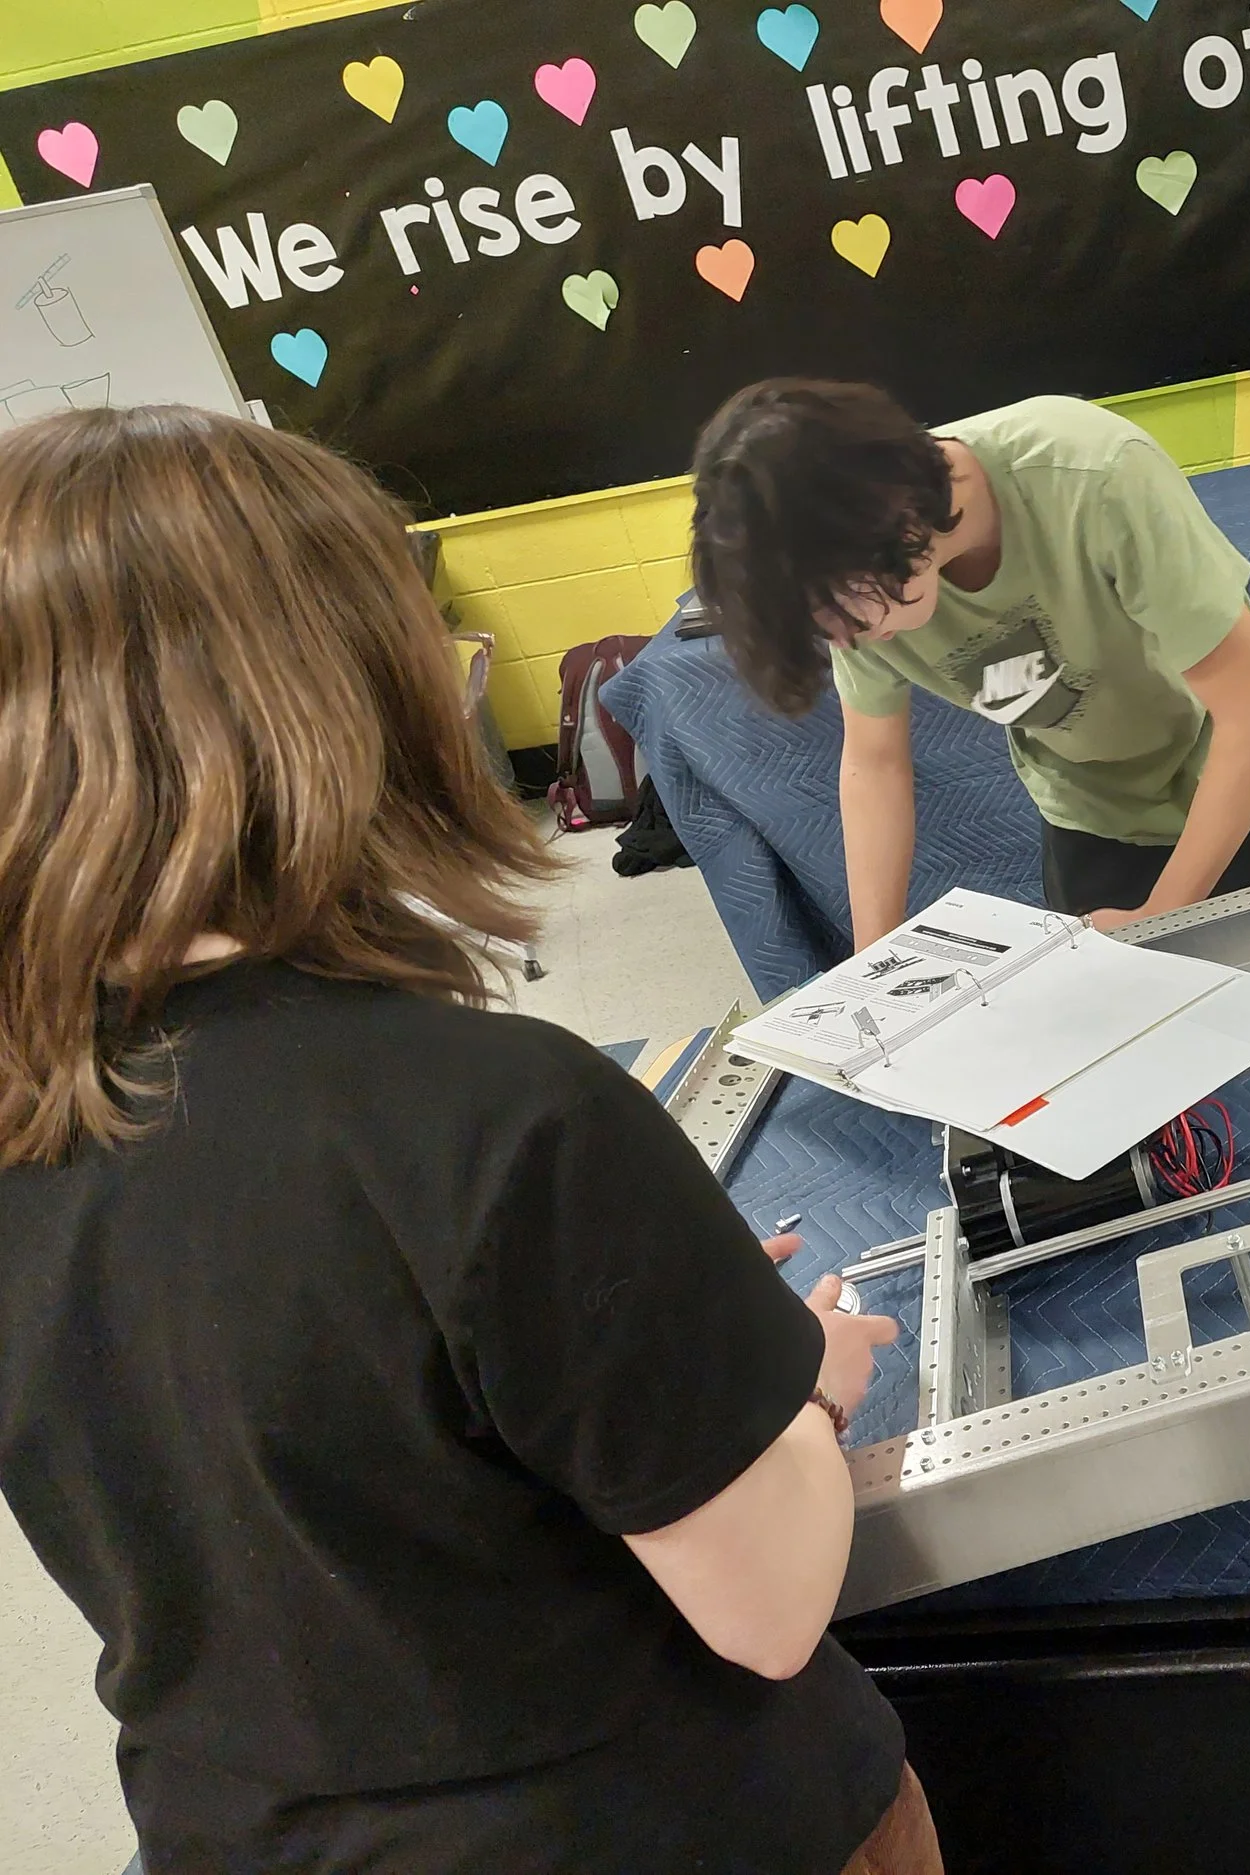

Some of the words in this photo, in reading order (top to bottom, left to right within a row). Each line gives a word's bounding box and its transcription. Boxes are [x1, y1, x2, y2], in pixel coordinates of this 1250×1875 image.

[181, 213, 345, 309] We
[380, 174, 582, 276] rise
[611, 128, 742, 228] by
[805, 53, 1127, 180] lifting
